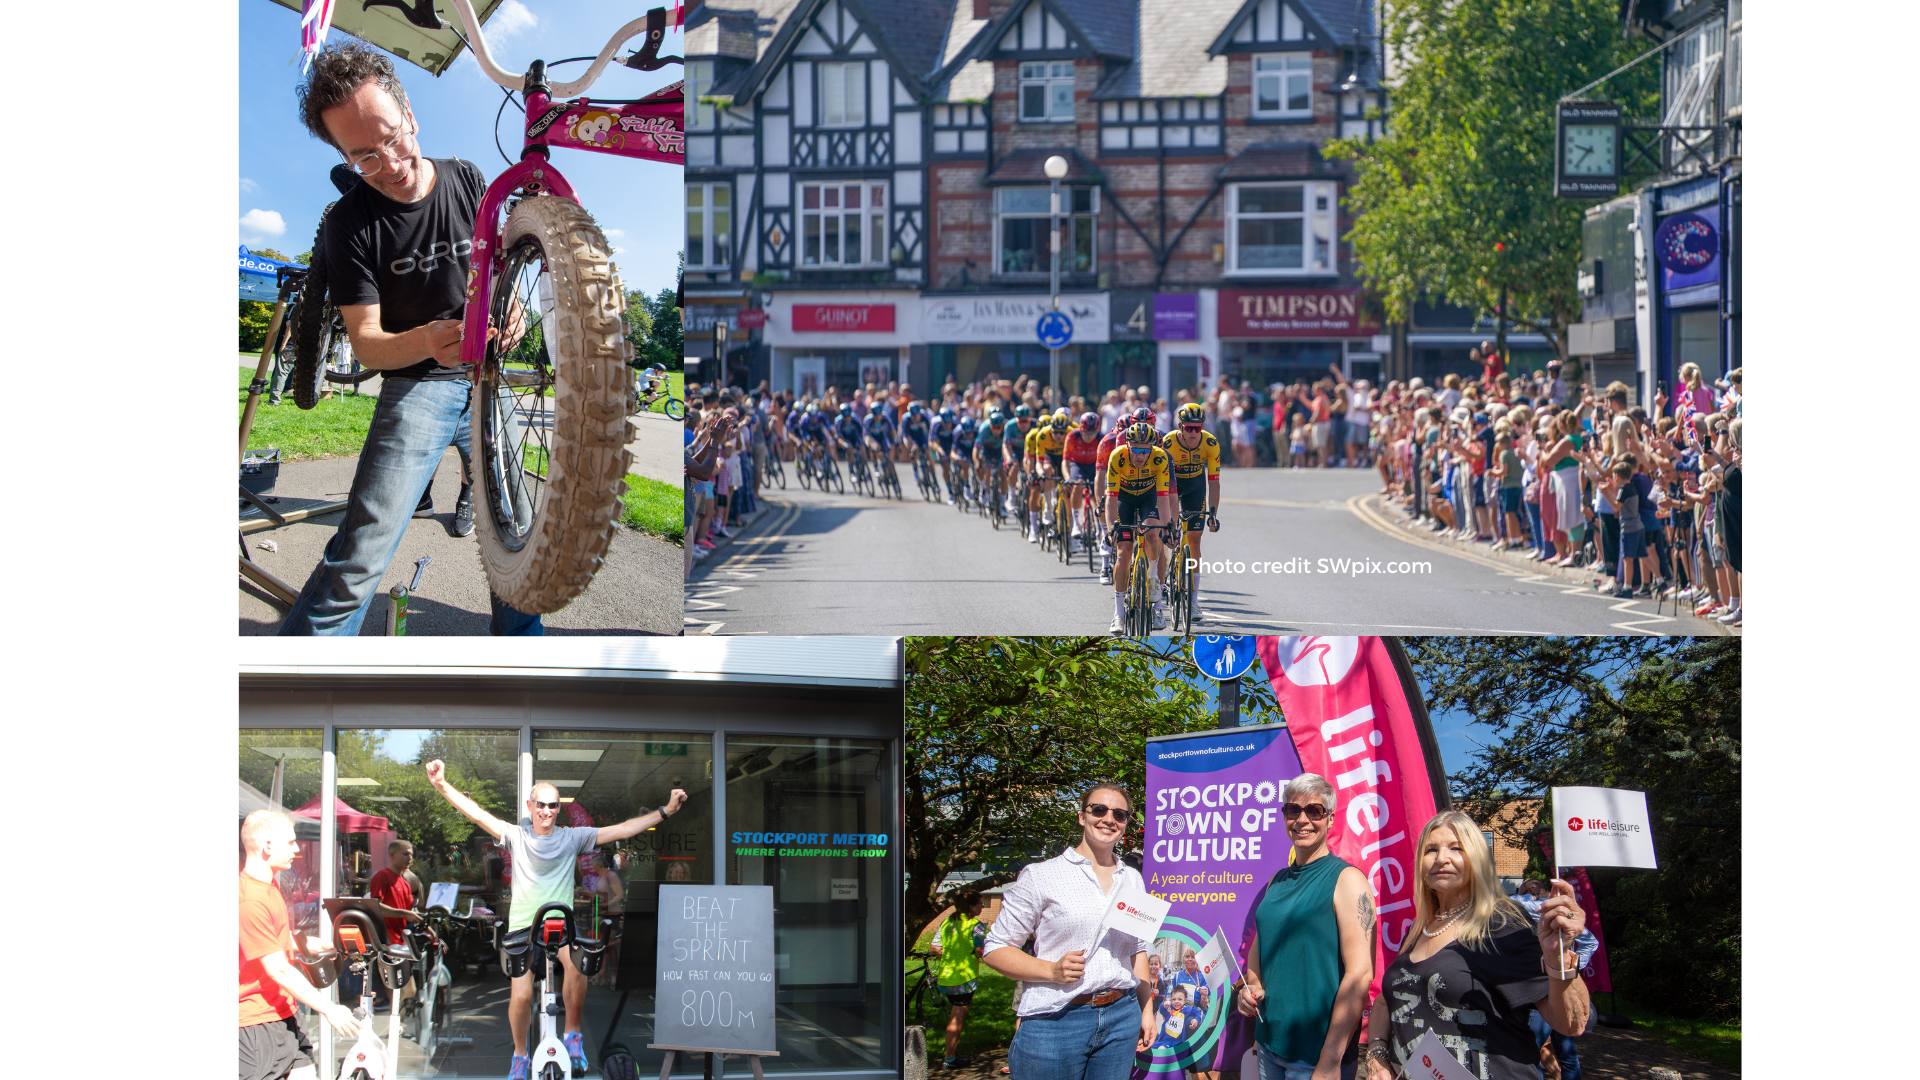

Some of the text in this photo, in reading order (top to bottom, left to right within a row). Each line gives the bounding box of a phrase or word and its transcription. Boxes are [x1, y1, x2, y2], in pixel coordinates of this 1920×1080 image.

[1238, 294, 1357, 318] TIMPSON
[815, 306, 869, 325] GUINOT
[1127, 302, 1147, 333] 4
[1158, 743, 1255, 760] stockporttownofculture.co.uk
[1156, 780, 1291, 812] STOCKPO
[1155, 808, 1277, 836] TOWN OF
[1588, 818, 1640, 833] lifeleisure
[731, 831, 888, 846] STOCKPORT METRO
[735, 848, 887, 858] WHERE CHAMPIONS GROW
[1152, 836, 1262, 863] CULTURE
[1150, 870, 1254, 887] A year of culture
[683, 895, 742, 920] BEAT
[1170, 892, 1237, 905] everyone
[691, 921, 729, 939] THE
[672, 937, 753, 963] SPRINT
[663, 969, 773, 983] HOW FAST CAN YOU GO
